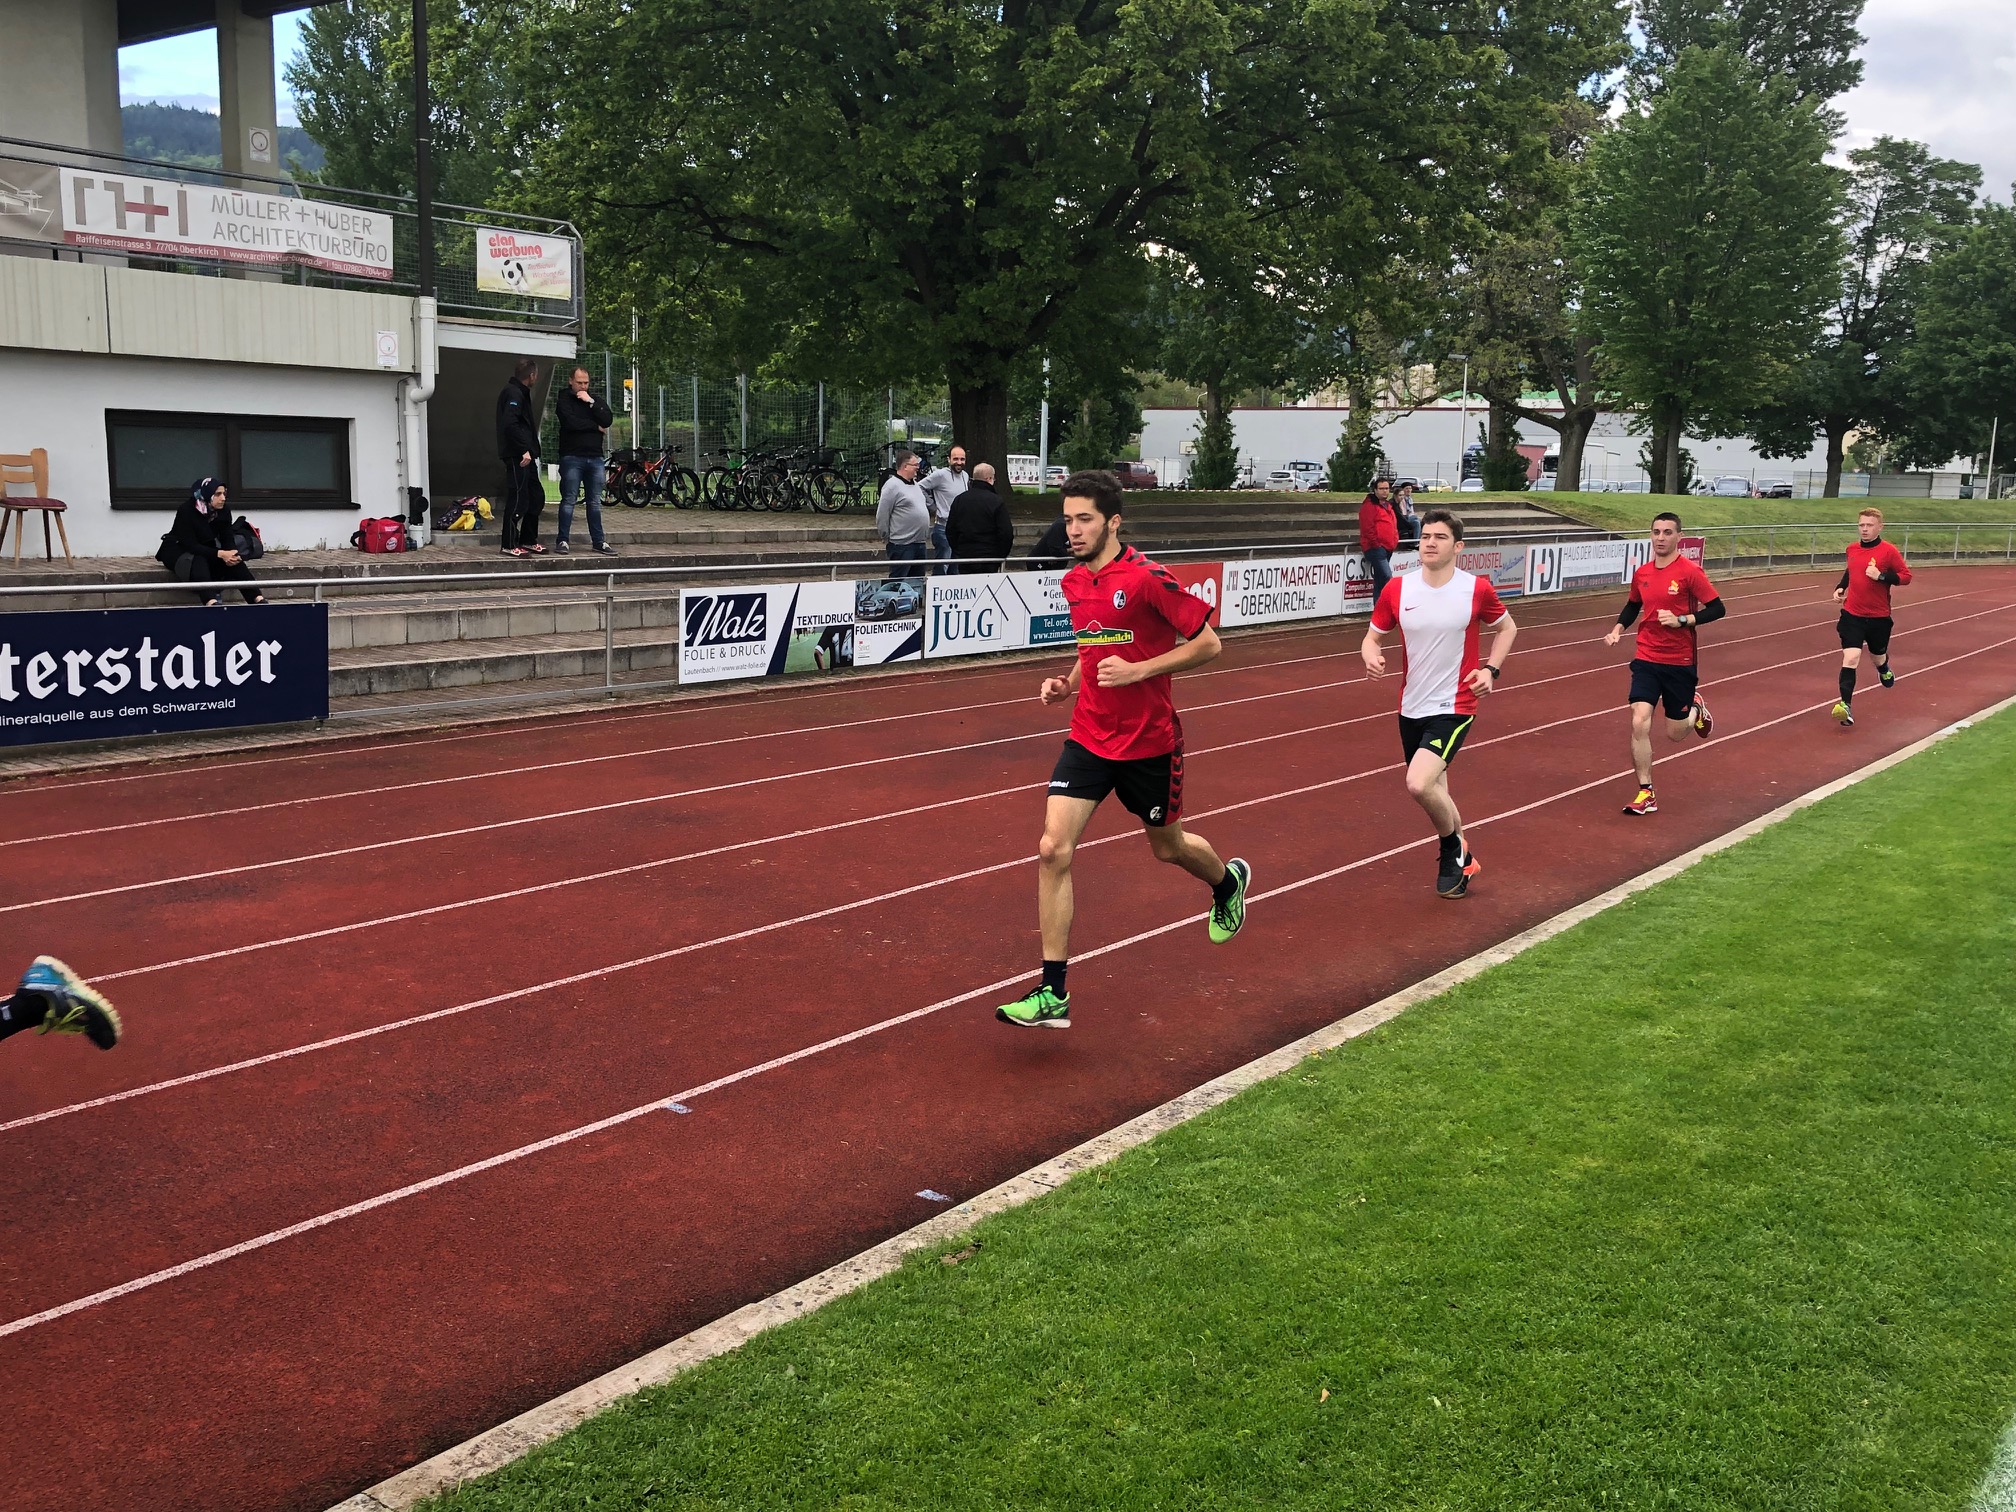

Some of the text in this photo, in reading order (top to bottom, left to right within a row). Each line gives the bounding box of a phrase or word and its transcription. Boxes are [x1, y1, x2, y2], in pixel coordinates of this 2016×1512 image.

[211, 192, 291, 222] MÜLLER
[314, 208, 373, 236] HUBER
[75, 234, 145, 249] Raiffeisenstrasse
[145, 242, 152, 250] 9
[156, 242, 178, 252] 77704
[179, 245, 219, 256] Oberkirch
[212, 221, 388, 262] ARCHITEKTURBÜRO
[488, 233, 515, 247] elan
[489, 244, 543, 258] werbung
[1242, 563, 1341, 590] STADTMARKETING
[1529, 547, 1562, 592] HDI
[932, 586, 977, 602] FLORIAN
[685, 594, 766, 646] Walz
[797, 612, 854, 626] TEXTILDRUCK
[855, 621, 917, 636] FOLIENTECHNIK
[928, 603, 994, 653] JÜLG
[1043, 618, 1055, 628] Tel.
[684, 643, 767, 661] FOLIE & DRUCK
[684, 664, 715, 676] Lautenbach
[721, 661, 767, 671] www.walz-folie.de
[89, 708, 114, 720] aus
[118, 704, 148, 717] dem
[152, 697, 236, 715] Schwarzwald
